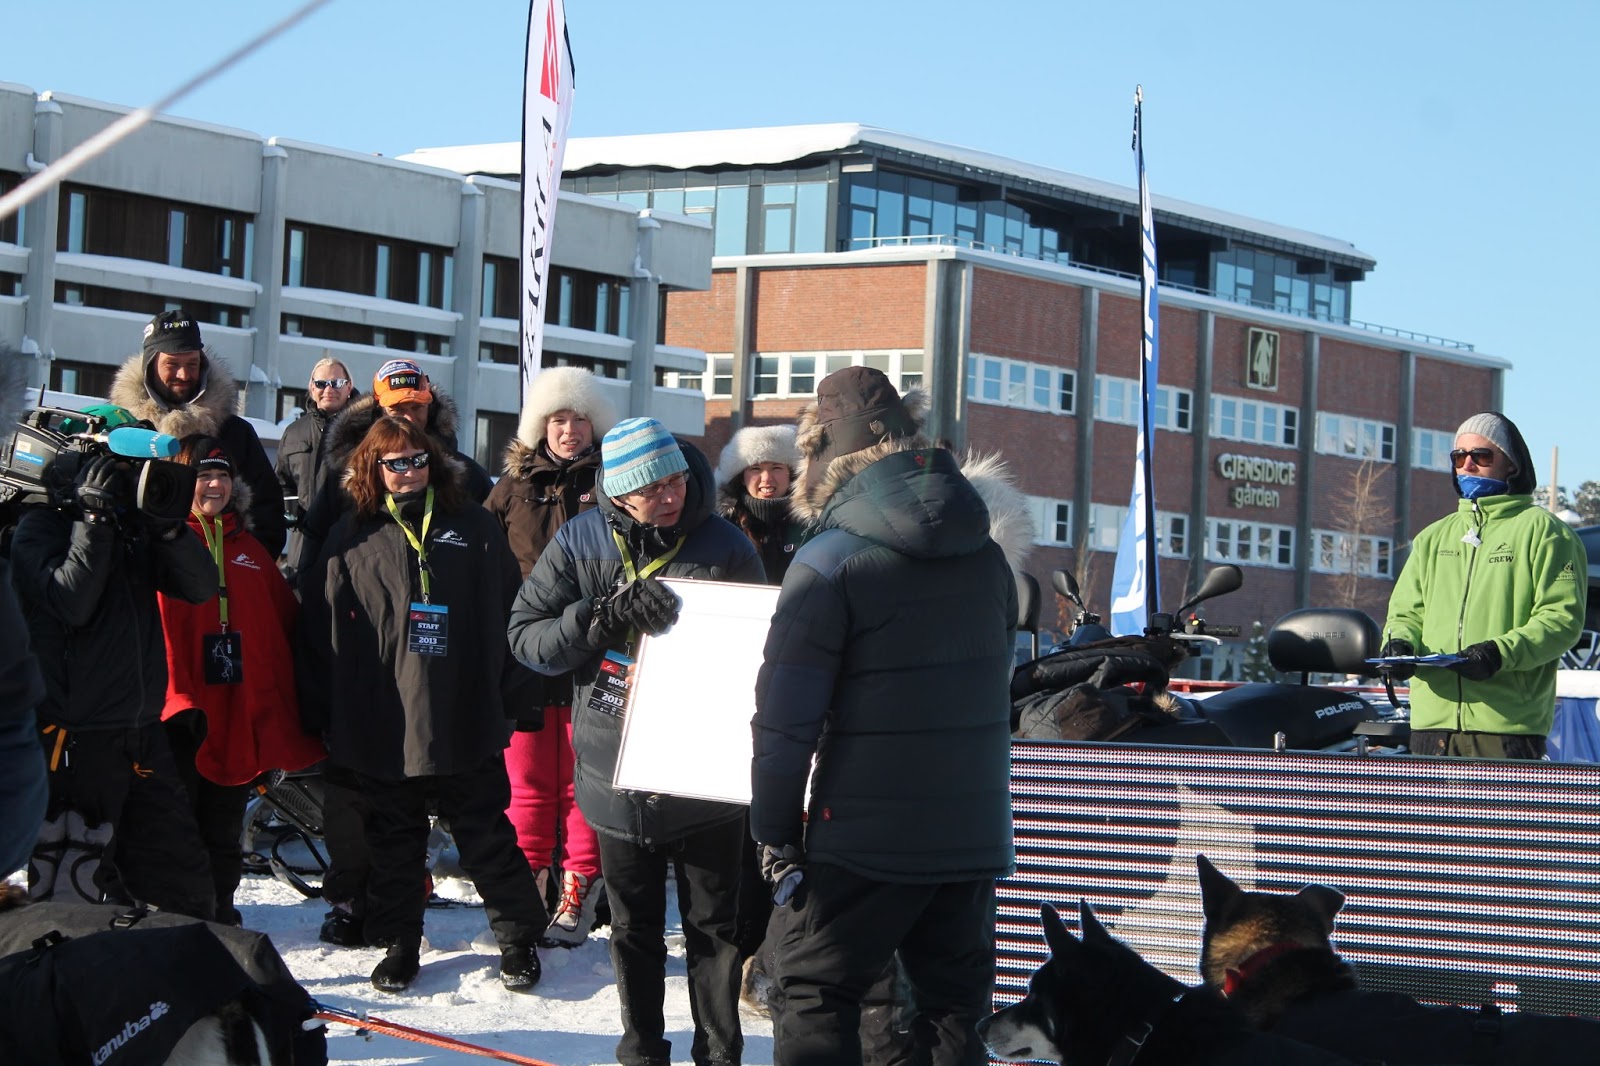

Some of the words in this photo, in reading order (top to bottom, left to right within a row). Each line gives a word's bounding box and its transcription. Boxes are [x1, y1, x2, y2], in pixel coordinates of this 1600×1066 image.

[390, 376, 417, 386] PROVIT
[1218, 453, 1297, 486] GJENSIDIGE
[1234, 482, 1280, 509] gården
[1488, 555, 1515, 564] CREW
[417, 622, 440, 630] STAFF
[418, 636, 438, 645] 2013
[607, 675, 631, 690] HOST
[601, 692, 625, 707] 2013
[1314, 701, 1364, 719] POLARIS
